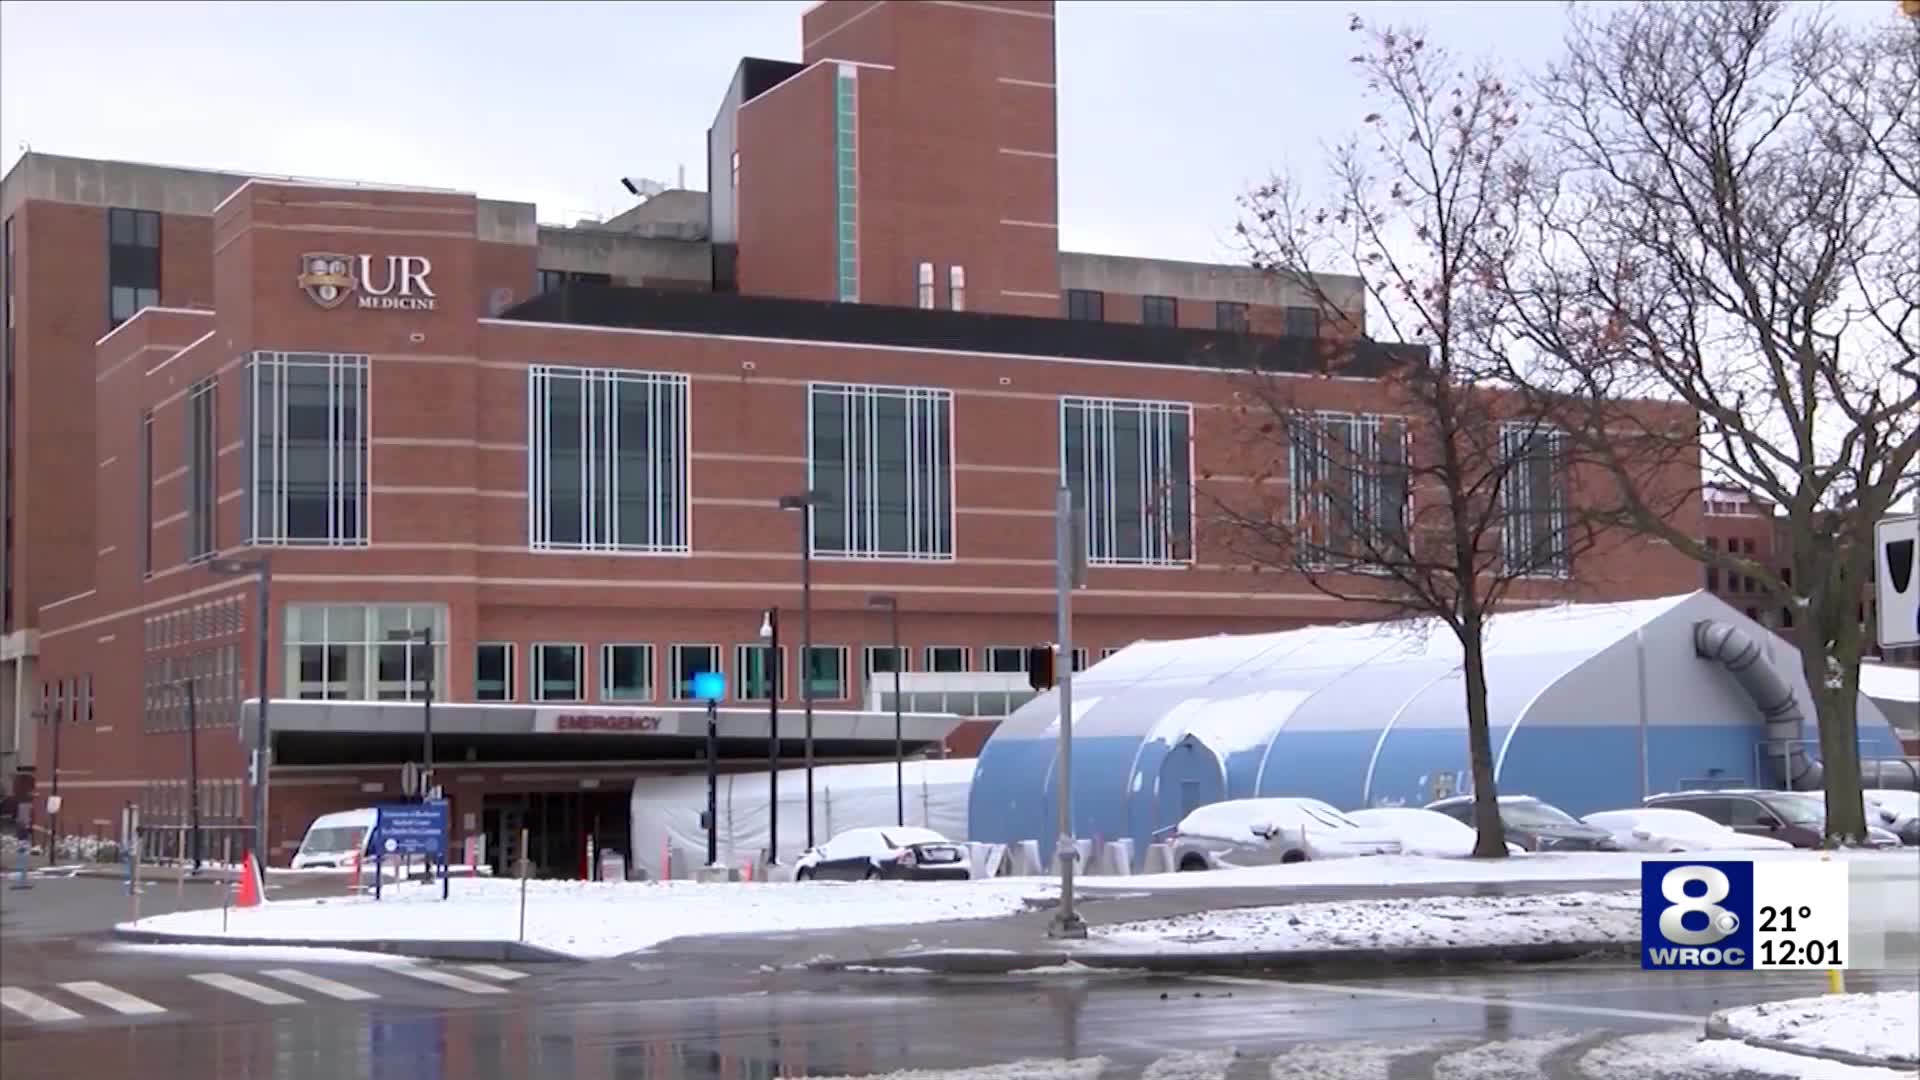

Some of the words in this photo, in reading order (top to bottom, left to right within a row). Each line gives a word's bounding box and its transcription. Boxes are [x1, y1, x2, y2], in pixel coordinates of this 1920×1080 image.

[358, 254, 436, 297] UR
[358, 296, 438, 310] MEDICINE
[556, 714, 662, 731] EMERGENCY
